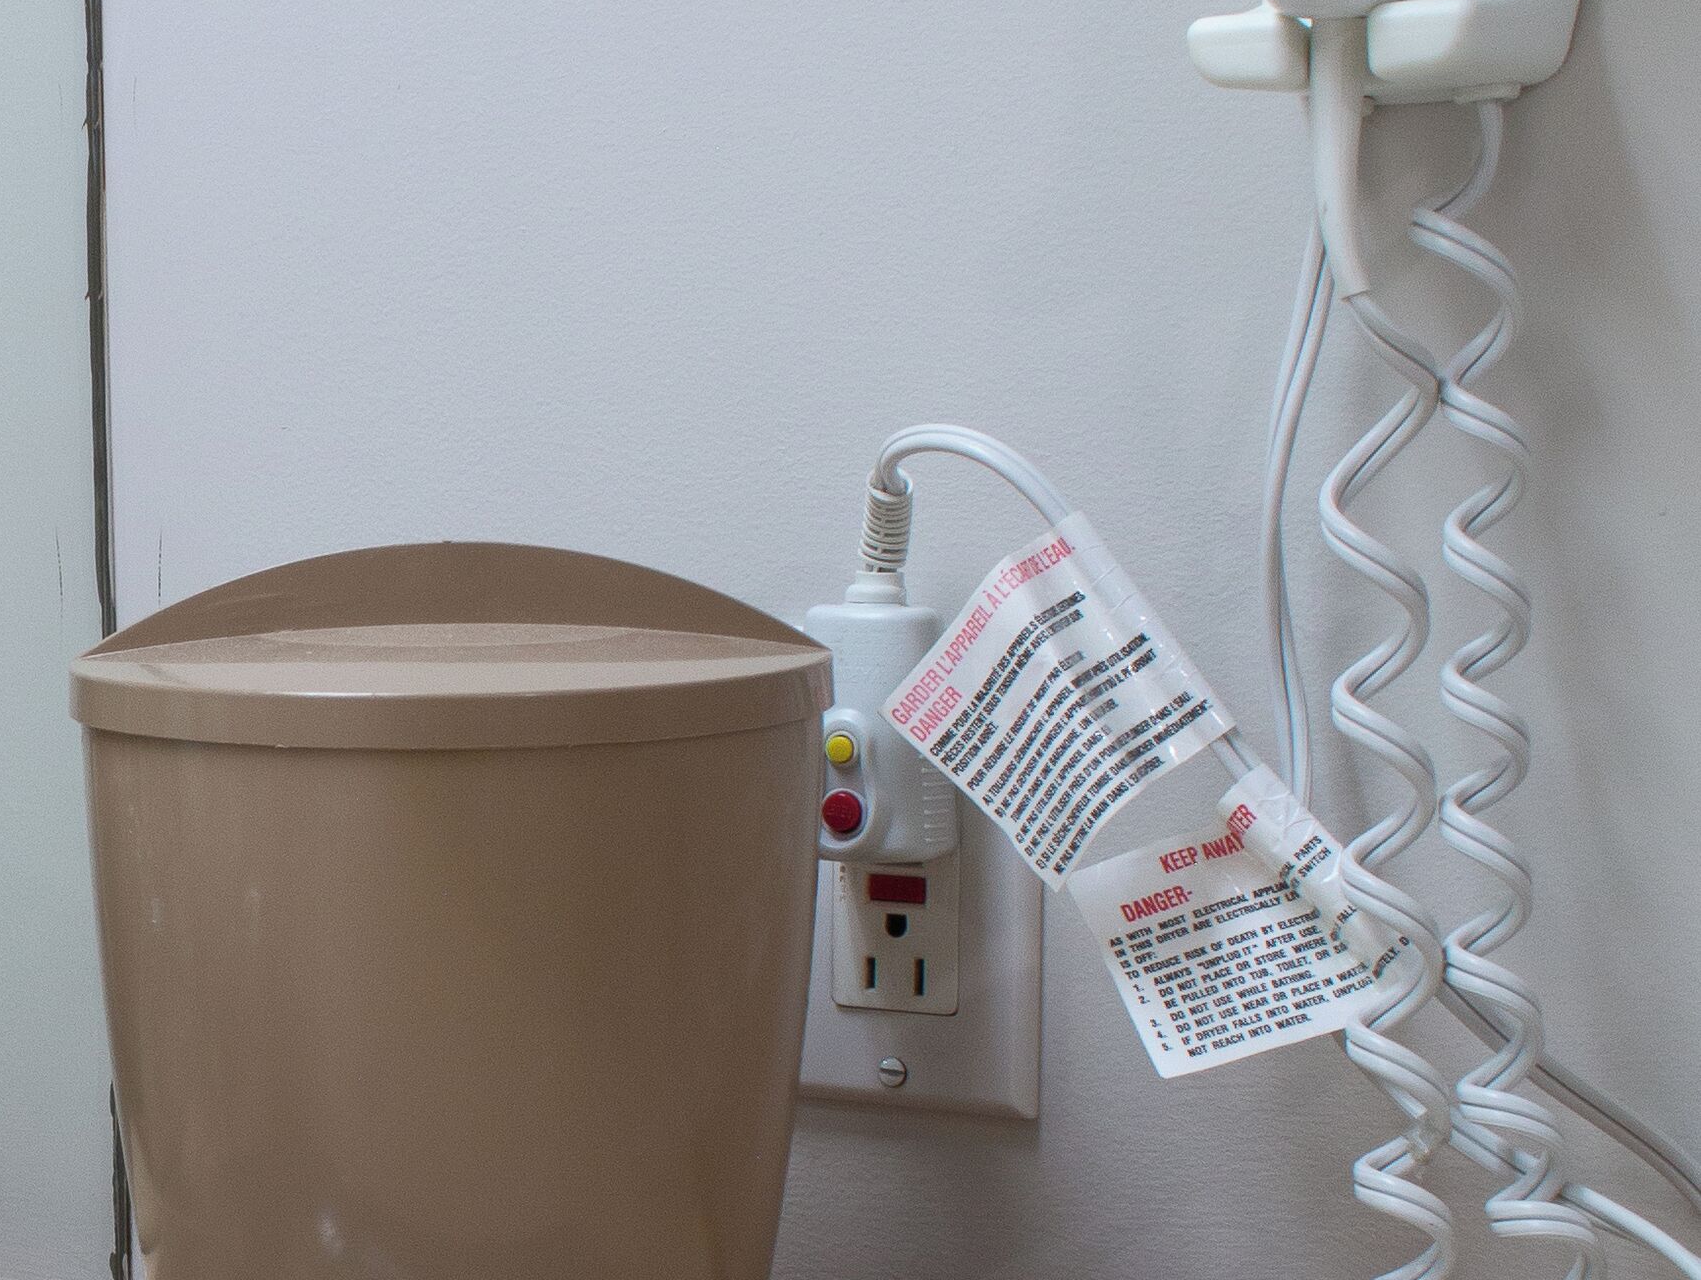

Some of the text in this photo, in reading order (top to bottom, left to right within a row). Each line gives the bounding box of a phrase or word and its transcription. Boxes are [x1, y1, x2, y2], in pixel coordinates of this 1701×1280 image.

[891, 670, 942, 723] GARDER
[936, 605, 991, 673] L'APPAREIL
[982, 590, 1002, 608] À
[911, 686, 961, 740] DANGER
[951, 709, 971, 730] POUR
[967, 701, 978, 712] LA
[951, 742, 980, 775] POSITION
[1159, 847, 1198, 872] KEEP
[1109, 936, 1122, 947] AS
[1126, 926, 1152, 941] WITH
[1157, 914, 1186, 930] MOST
[1192, 893, 1247, 918] ELECTRICAL
[1293, 834, 1323, 862] PARTS
[1114, 948, 1126, 957] IN
[1129, 939, 1152, 952] THIS
[1156, 926, 1189, 943] DRYER
[1192, 918, 1211, 931] ARE
[1215, 896, 1279, 923] ELECTRICALLY
[1297, 847, 1332, 878] SWITCH
[1121, 884, 1193, 921] DANGER-
[1119, 959, 1130, 968] IS
[1125, 924, 1273, 980] TO REDUCE RISK OF DEATH BY
[1132, 982, 1143, 992] 1.
[1153, 966, 1191, 985] ALWAYS
[1264, 932, 1294, 948] AFTER
[1137, 994, 1149, 1004] 2.
[1158, 986, 1173, 997] DO
[1177, 978, 1197, 991] NOT
[1201, 966, 1232, 982] PLACE
[1235, 960, 1250, 971] OR
[1254, 948, 1286, 966] STORE
[1291, 936, 1326, 953] WHERE
[1164, 998, 1177, 1009] BE
[1181, 984, 1218, 1003] PULLED
[1222, 975, 1245, 989] INTO
[1314, 949, 1329, 960] OR
[1170, 1010, 1184, 1021] DO
[1189, 1002, 1209, 1014] NOT
[1212, 994, 1233, 1007] USE
[1236, 982, 1267, 999] WHILE
[1176, 1022, 1191, 1033] DO
[1194, 1014, 1214, 1027] NOT
[1218, 1006, 1238, 1019] USE
[1242, 996, 1268, 1011] NEAR
[1272, 990, 1287, 1001] OR
[1290, 980, 1320, 997] PLACE
[1322, 977, 1333, 987] IN
[1181, 1036, 1191, 1045] IF
[1195, 1023, 1228, 1041] DRYER
[1231, 1012, 1261, 1028] FALLS
[1265, 1004, 1288, 1018] INTO
[1187, 1044, 1207, 1057] NOT
[1211, 1032, 1244, 1049] REACH
[1248, 1024, 1271, 1037] INTO
